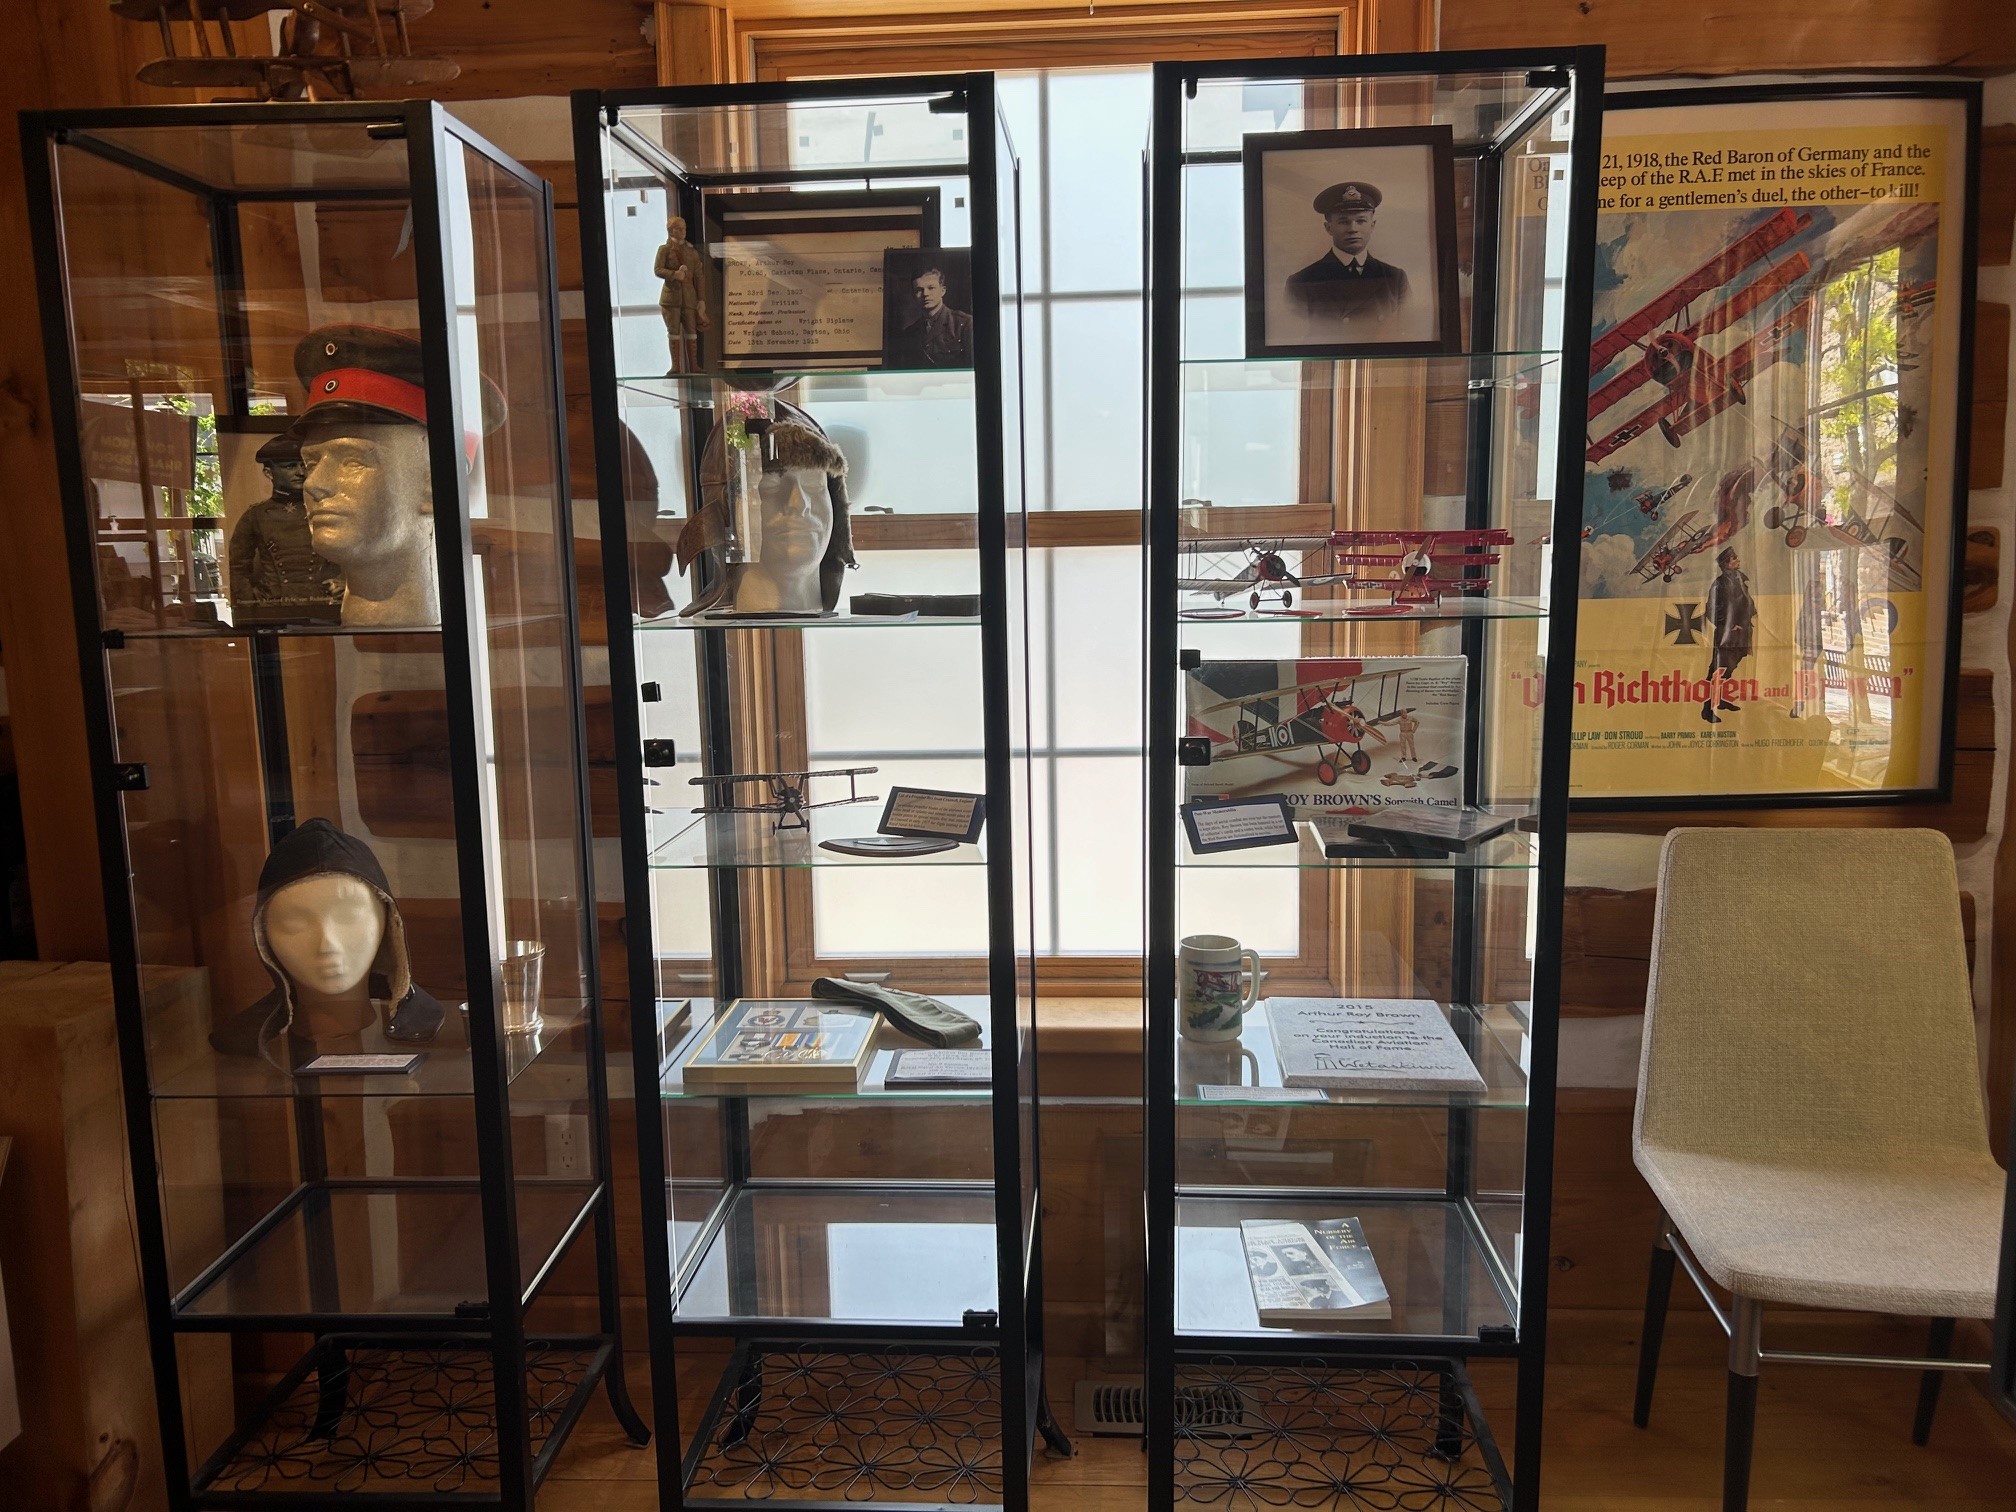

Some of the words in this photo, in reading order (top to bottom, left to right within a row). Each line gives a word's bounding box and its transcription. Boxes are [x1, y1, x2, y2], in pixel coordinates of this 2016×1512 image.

[1602, 154, 1623, 171] 21,
[1626, 153, 1663, 170] 1918,
[1665, 152, 1688, 167] the
[1692, 150, 1722, 166] Red
[1726, 149, 1774, 165] Baron
[1777, 147, 1795, 162] of
[1797, 147, 1869, 163] Germany
[1873, 145, 1902, 159] and
[1907, 144, 1931, 158] the
[1598, 175, 1627, 189] eep
[1631, 171, 1648, 186] of
[1650, 170, 1674, 185] the
[1679, 168, 1723, 184] R.A.F.
[1727, 169, 1756, 182] met
[1761, 166, 1775, 181] in
[1781, 165, 1804, 180] the
[1808, 163, 1846, 179] skies
[1850, 162, 1869, 177] of
[1871, 162, 1925, 177] France.
[1620, 193, 1642, 208] for
[1645, 196, 1655, 207] a
[1658, 188, 1747, 209] gentlemen's
[1751, 187, 1788, 204] duel,
[1792, 186, 1816, 201] the
[1889, 182, 1919, 198] kill!
[1593, 667, 1759, 709] Richthofen
[1764, 684, 1790, 698] and
[1604, 731, 1617, 740] DON
[1619, 730, 1643, 740] STROUD
[1312, 793, 1382, 806] BROWN'S
[1426, 797, 1457, 806] Camel
[1316, 1028, 1415, 1036] Congratulations
[1338, 1059, 1455, 1070] Wetaskiwin
